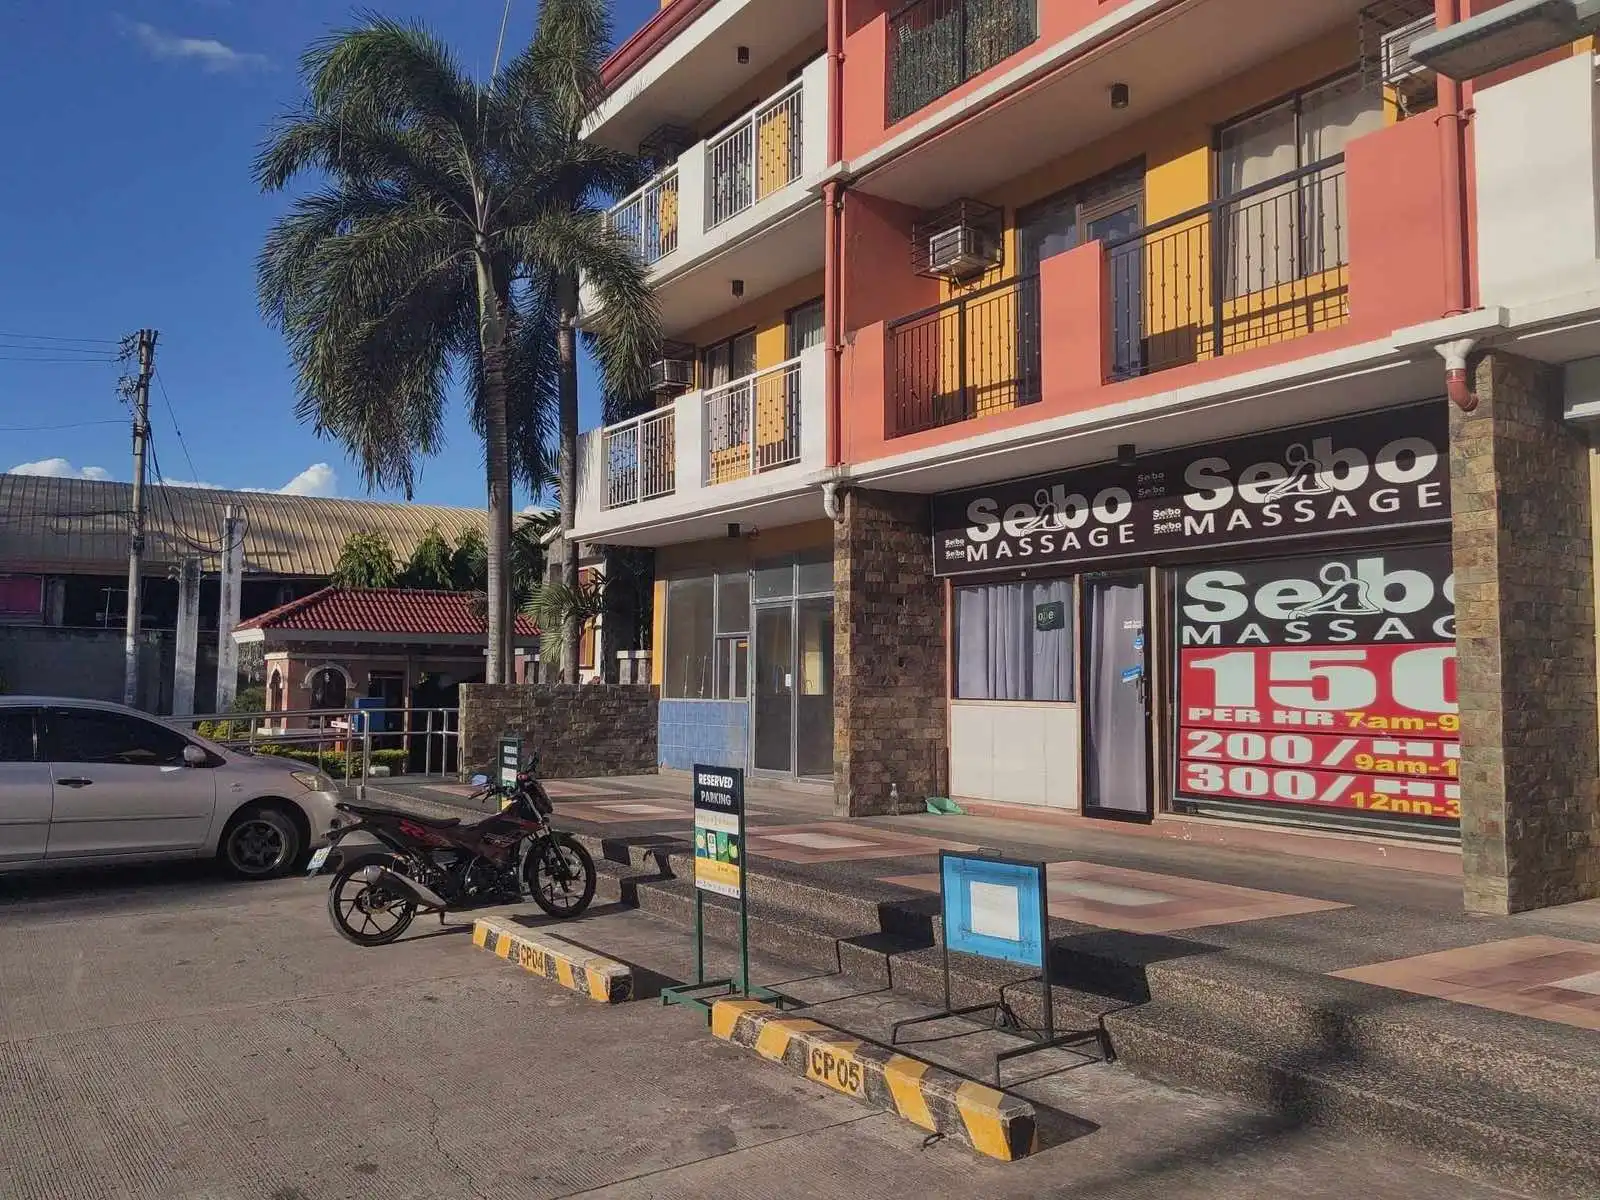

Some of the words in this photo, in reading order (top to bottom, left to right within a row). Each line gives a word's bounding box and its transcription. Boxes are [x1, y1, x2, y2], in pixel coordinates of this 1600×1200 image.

[1183, 482, 1443, 536] MASSAGE
[966, 523, 1135, 563] MASSAGE
[1188, 707, 1261, 724] PER
[1272, 709, 1335, 727] HR
[698, 773, 733, 789] RESERVED
[700, 790, 732, 806] PARKING
[811, 1047, 860, 1093] CP05
